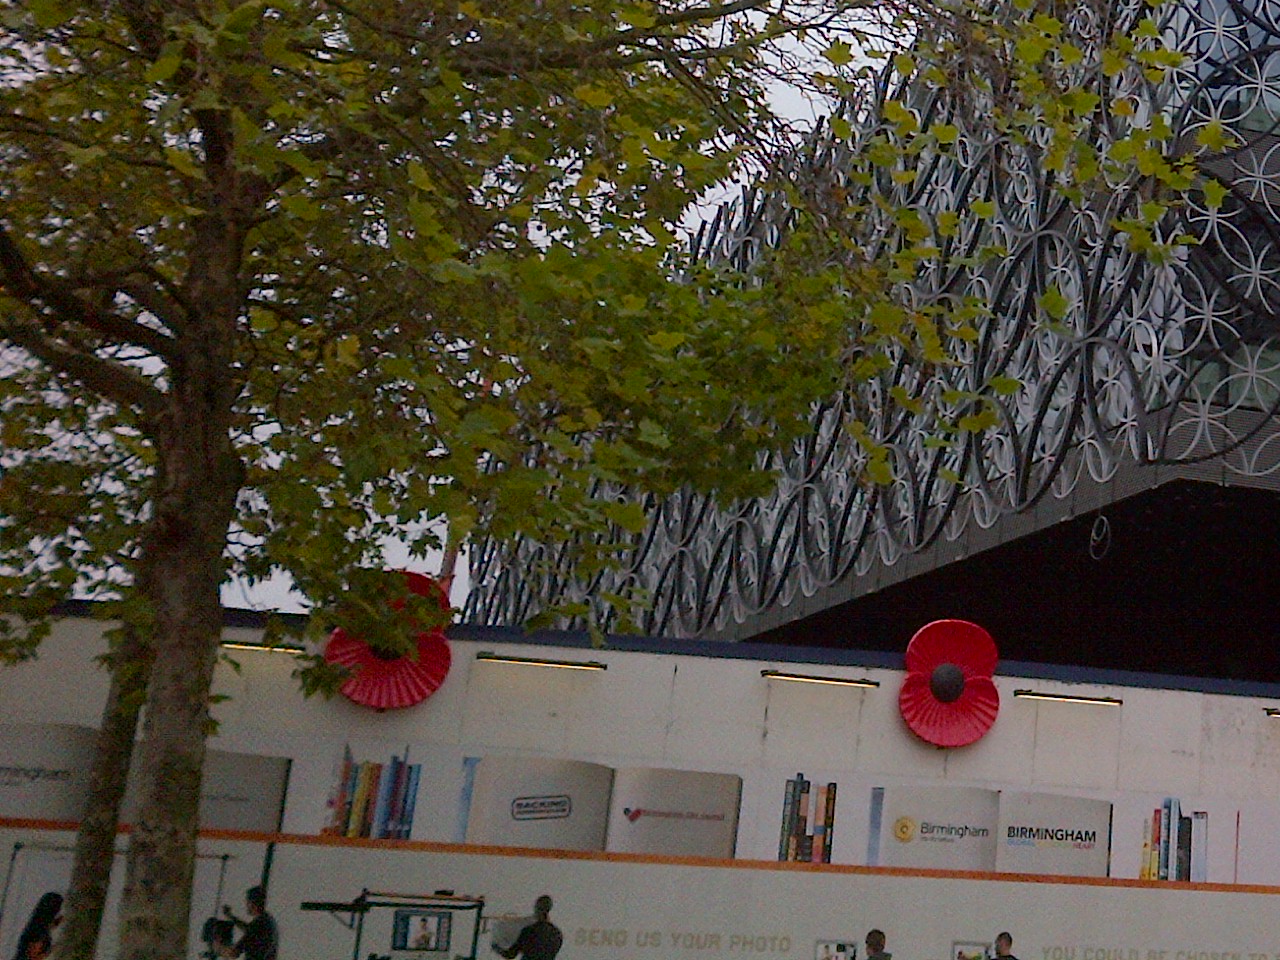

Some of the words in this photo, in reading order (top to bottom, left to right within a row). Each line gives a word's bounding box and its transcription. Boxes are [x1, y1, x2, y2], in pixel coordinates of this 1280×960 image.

[920, 822, 989, 839] Birmingham
[1007, 826, 1097, 843] BIRMINGHAM
[575, 927, 628, 947] SEND
[636, 930, 662, 948] US
[671, 932, 721, 951] YOUR
[729, 934, 791, 953] PHOTO
